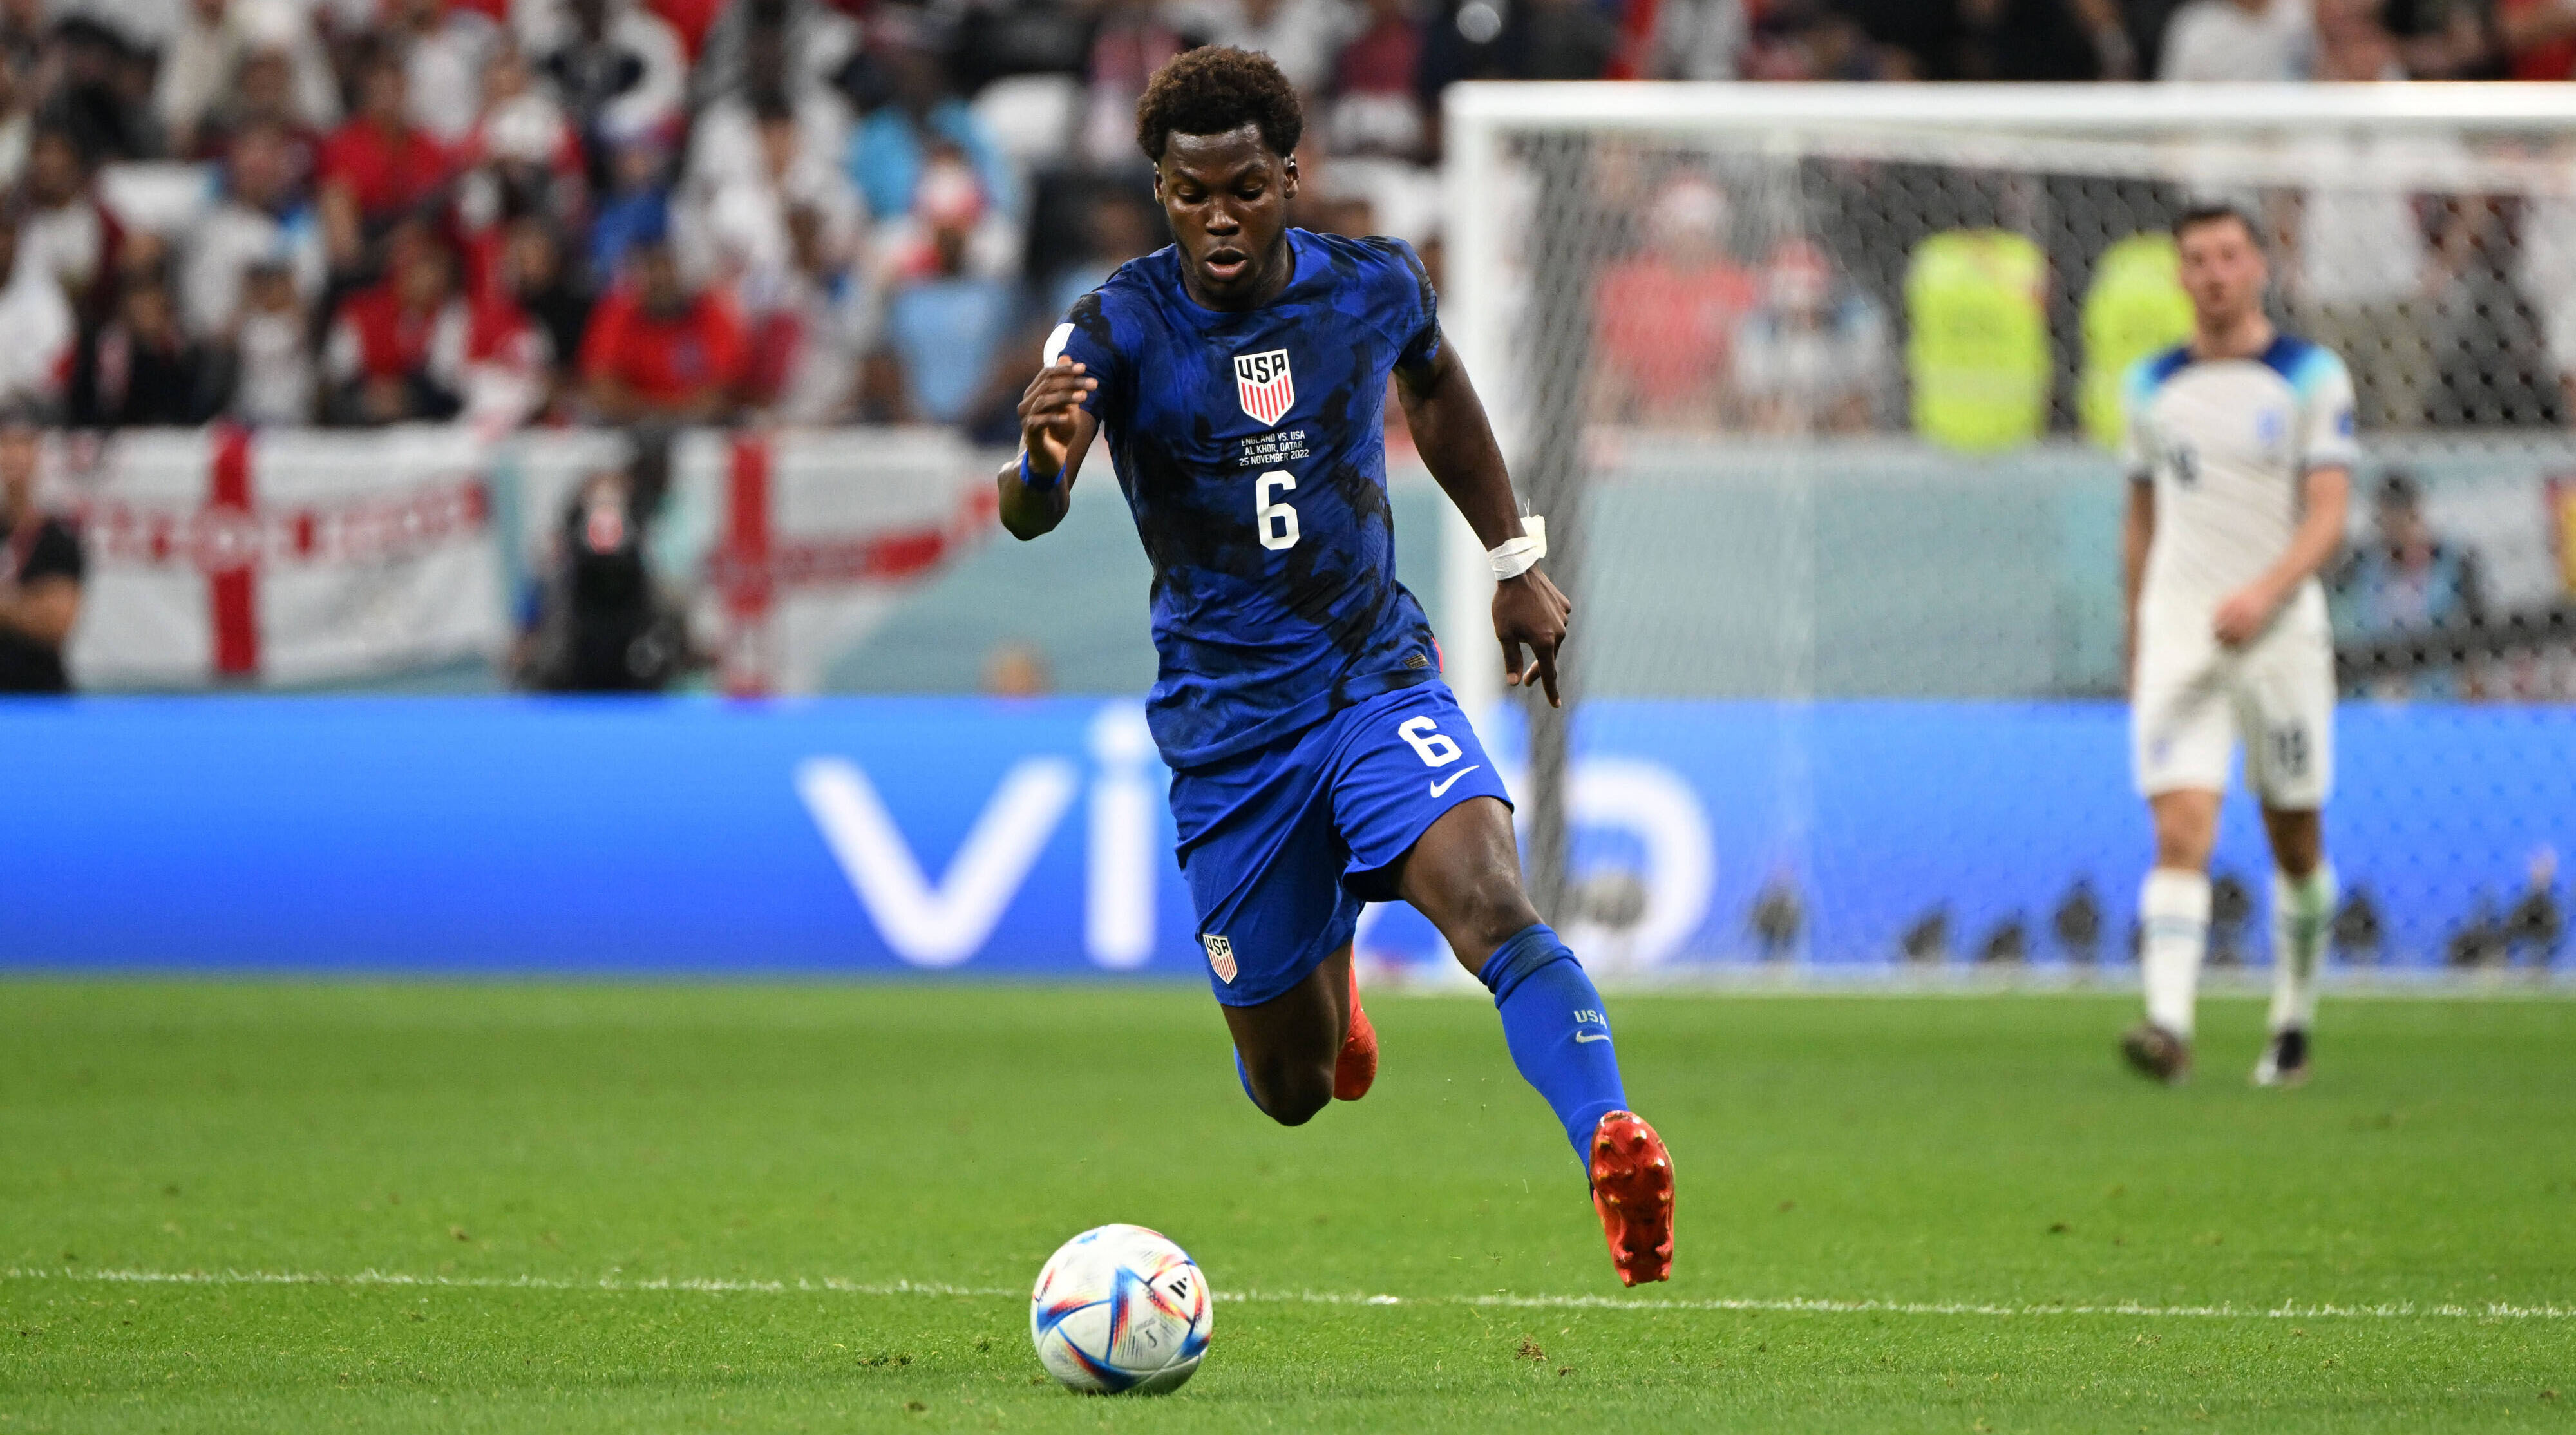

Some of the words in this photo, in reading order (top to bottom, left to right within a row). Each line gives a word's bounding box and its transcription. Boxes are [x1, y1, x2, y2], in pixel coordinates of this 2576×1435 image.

[1238, 353, 1285, 384] USA
[1241, 433, 1276, 446] ENGLAND
[1277, 432, 1289, 441] VS.
[1290, 430, 1305, 440] USA
[1239, 457, 1249, 466] 25
[1251, 453, 1289, 464] NOVEMBER
[1291, 449, 1309, 459] 2022
[1245, 446, 1255, 455] AL
[1256, 443, 1279, 454] KHOR,
[1256, 470, 1300, 551] 6
[1397, 716, 1463, 767] 6
[1205, 936, 1229, 956] USA
[1574, 1009, 1608, 1030] USA
